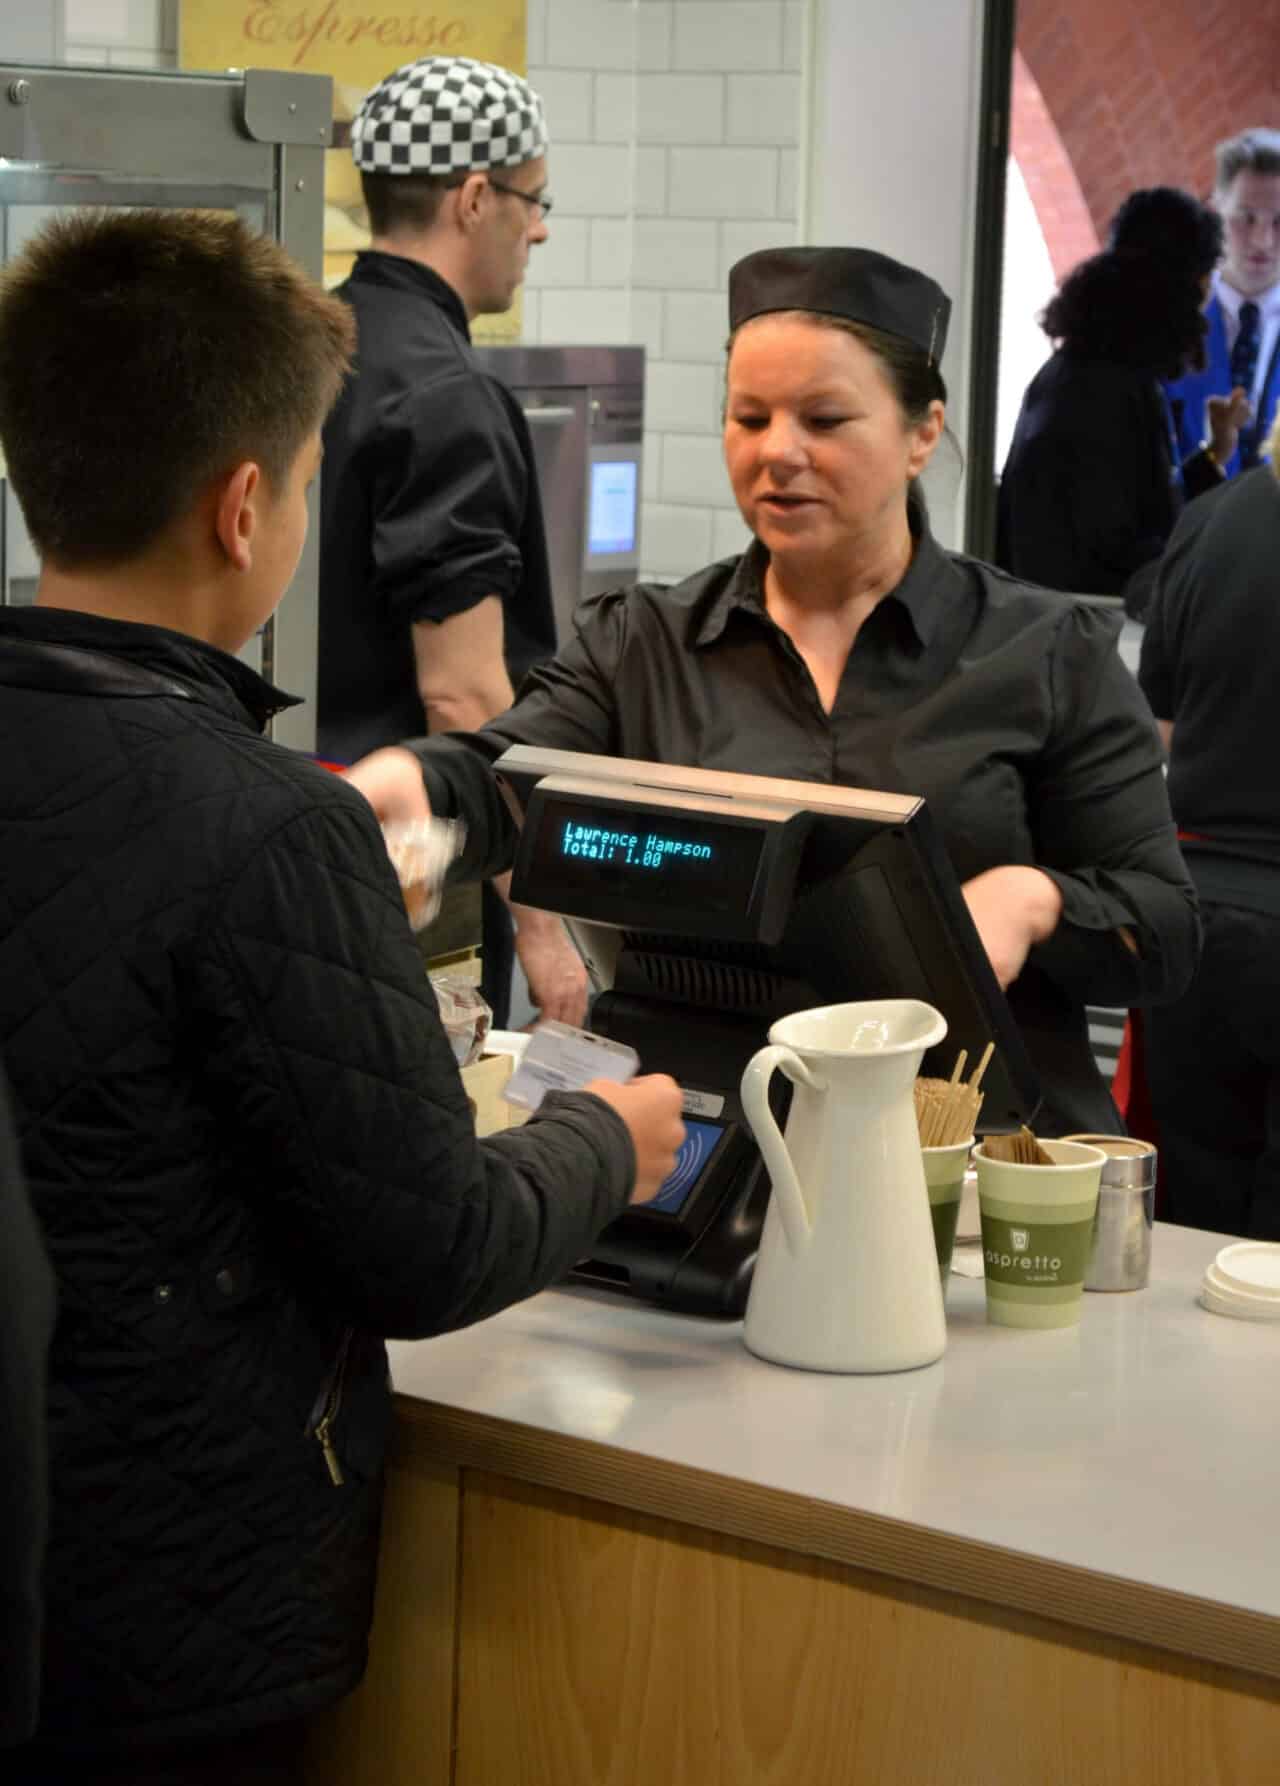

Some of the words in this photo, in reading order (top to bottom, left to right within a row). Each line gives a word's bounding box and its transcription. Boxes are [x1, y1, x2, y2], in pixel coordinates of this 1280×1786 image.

[243, 0, 467, 64] Espresso
[564, 838, 614, 860] Total:
[625, 848, 661, 867] 1.00
[565, 822, 638, 847] Lawrence
[646, 834, 711, 858] Hampson
[985, 1250, 1061, 1270] aspretto
